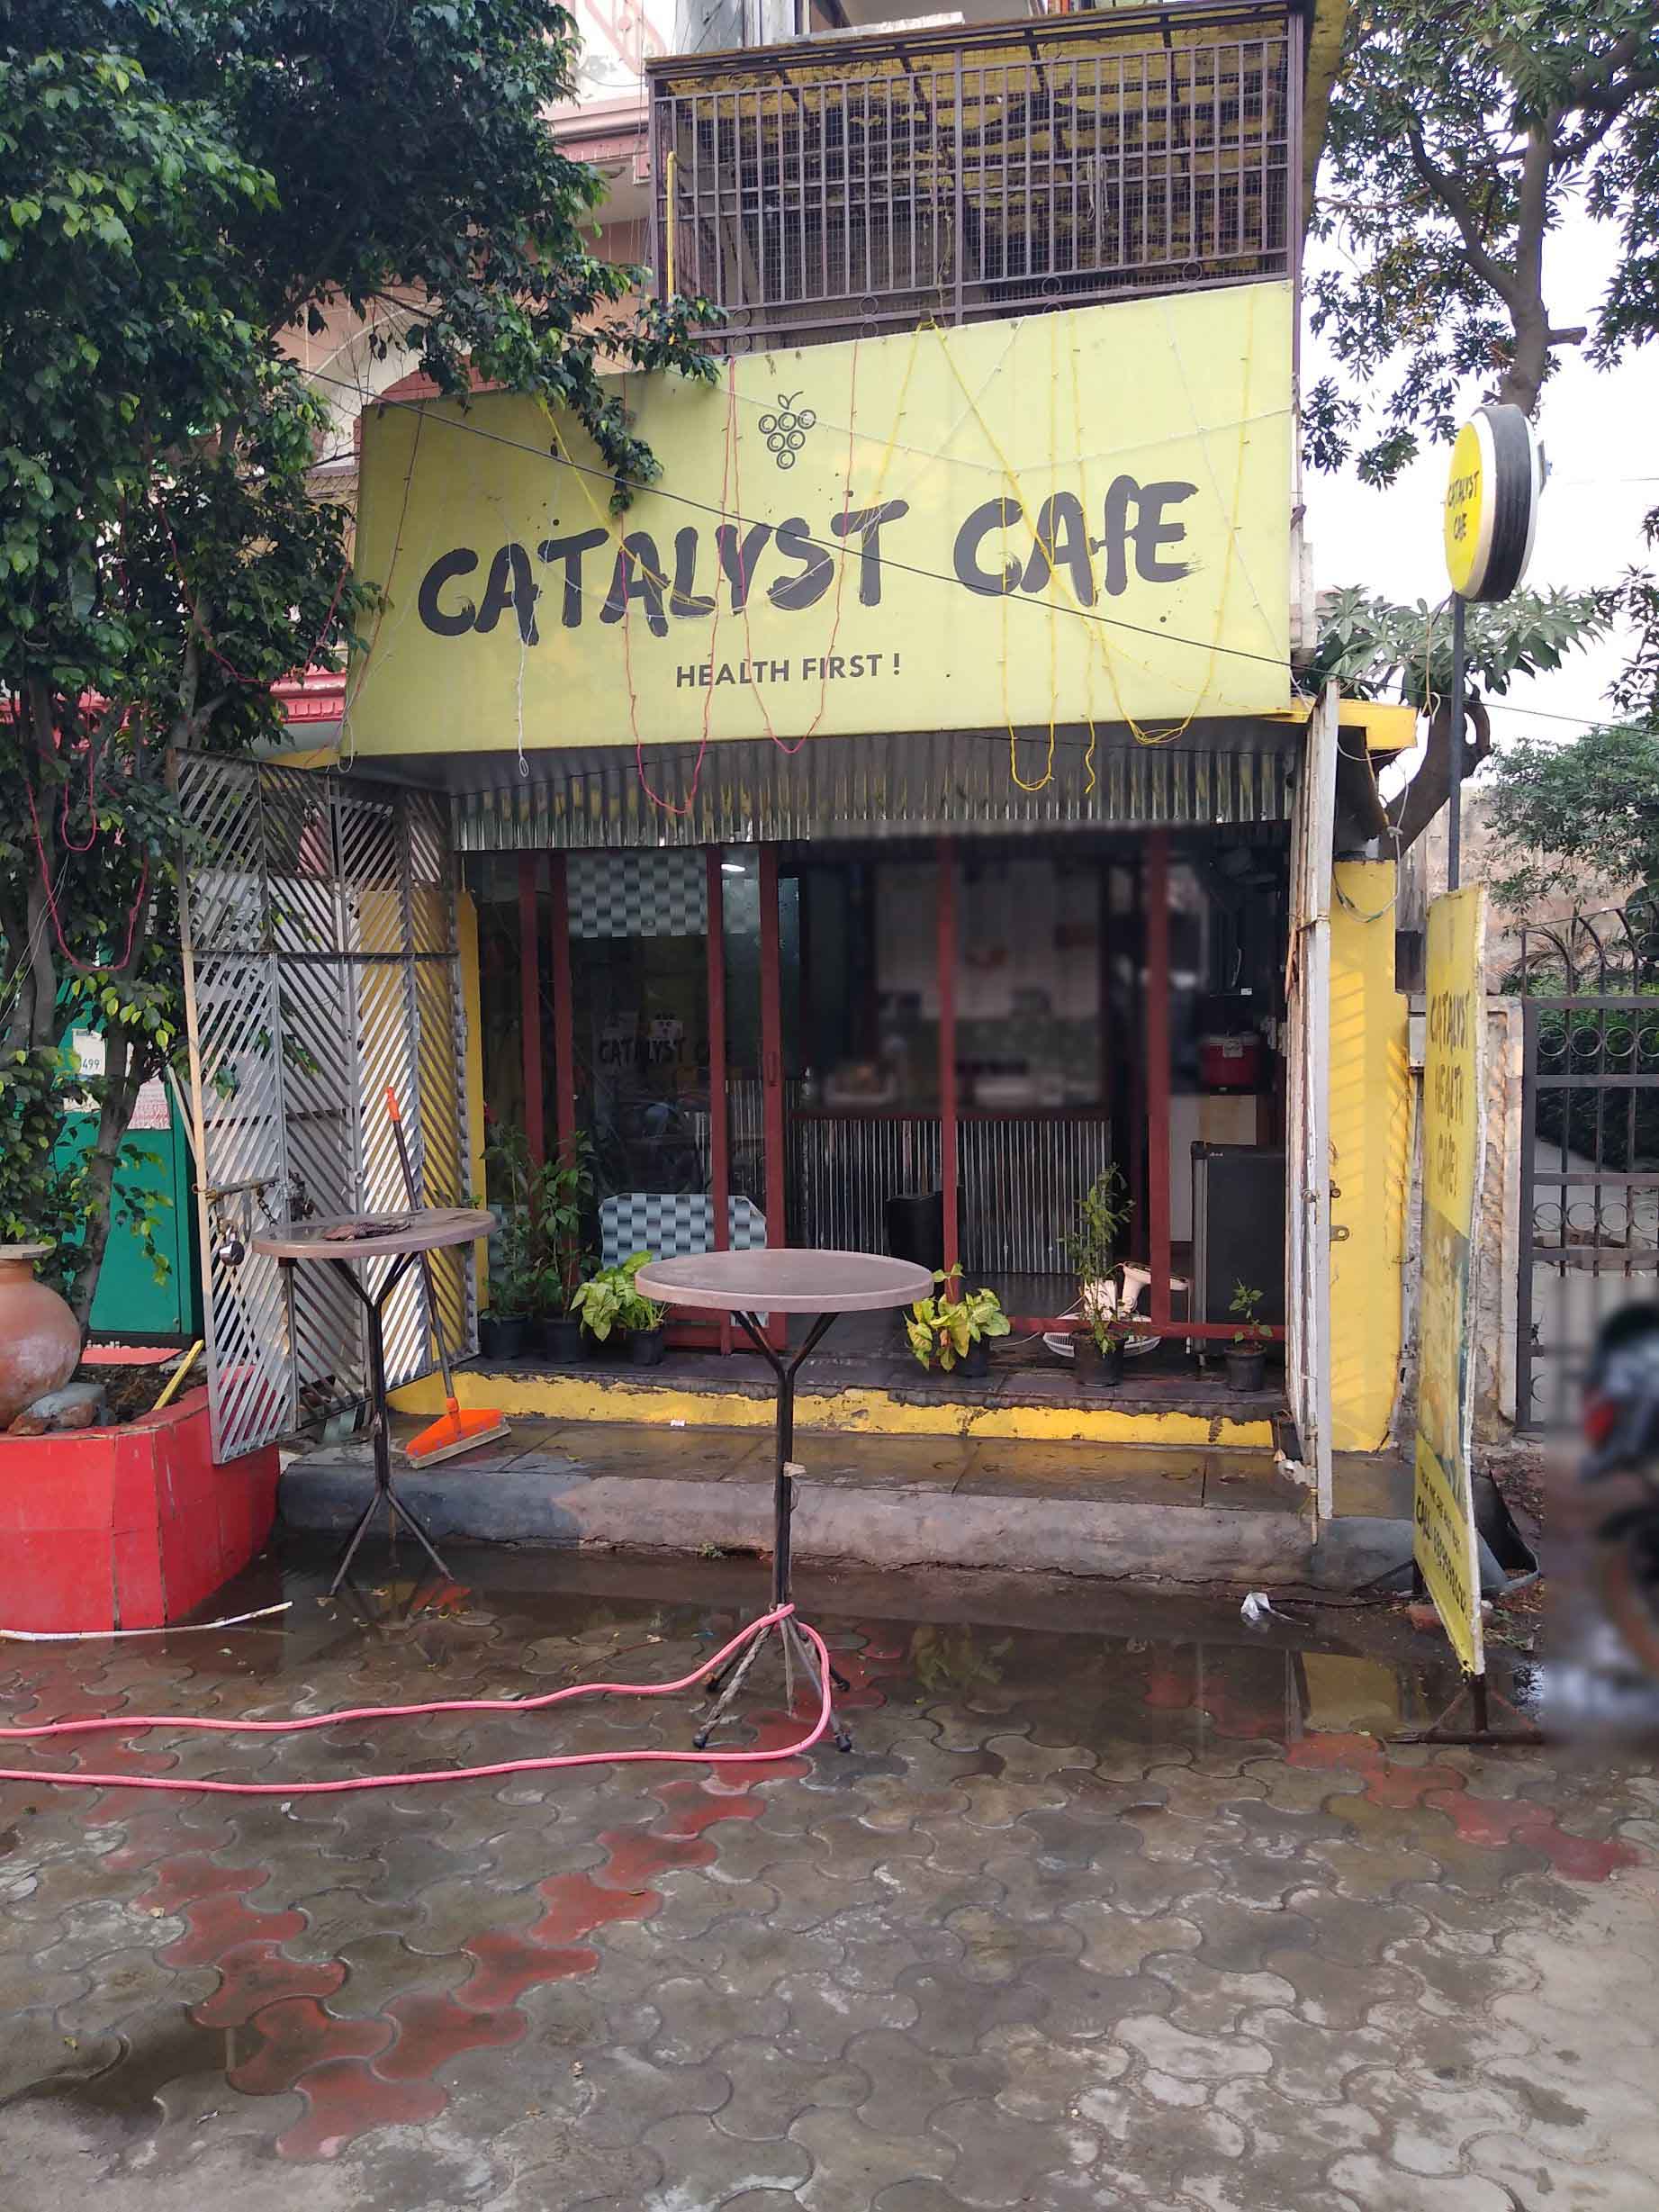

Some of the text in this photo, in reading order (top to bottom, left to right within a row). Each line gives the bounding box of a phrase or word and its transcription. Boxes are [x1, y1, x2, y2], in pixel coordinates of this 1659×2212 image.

[417, 474, 1201, 647] CATALYST CAFE
[676, 660, 790, 689] HEALTH
[803, 654, 884, 682] FIRST
[1429, 989, 1470, 1054] CATALYST
